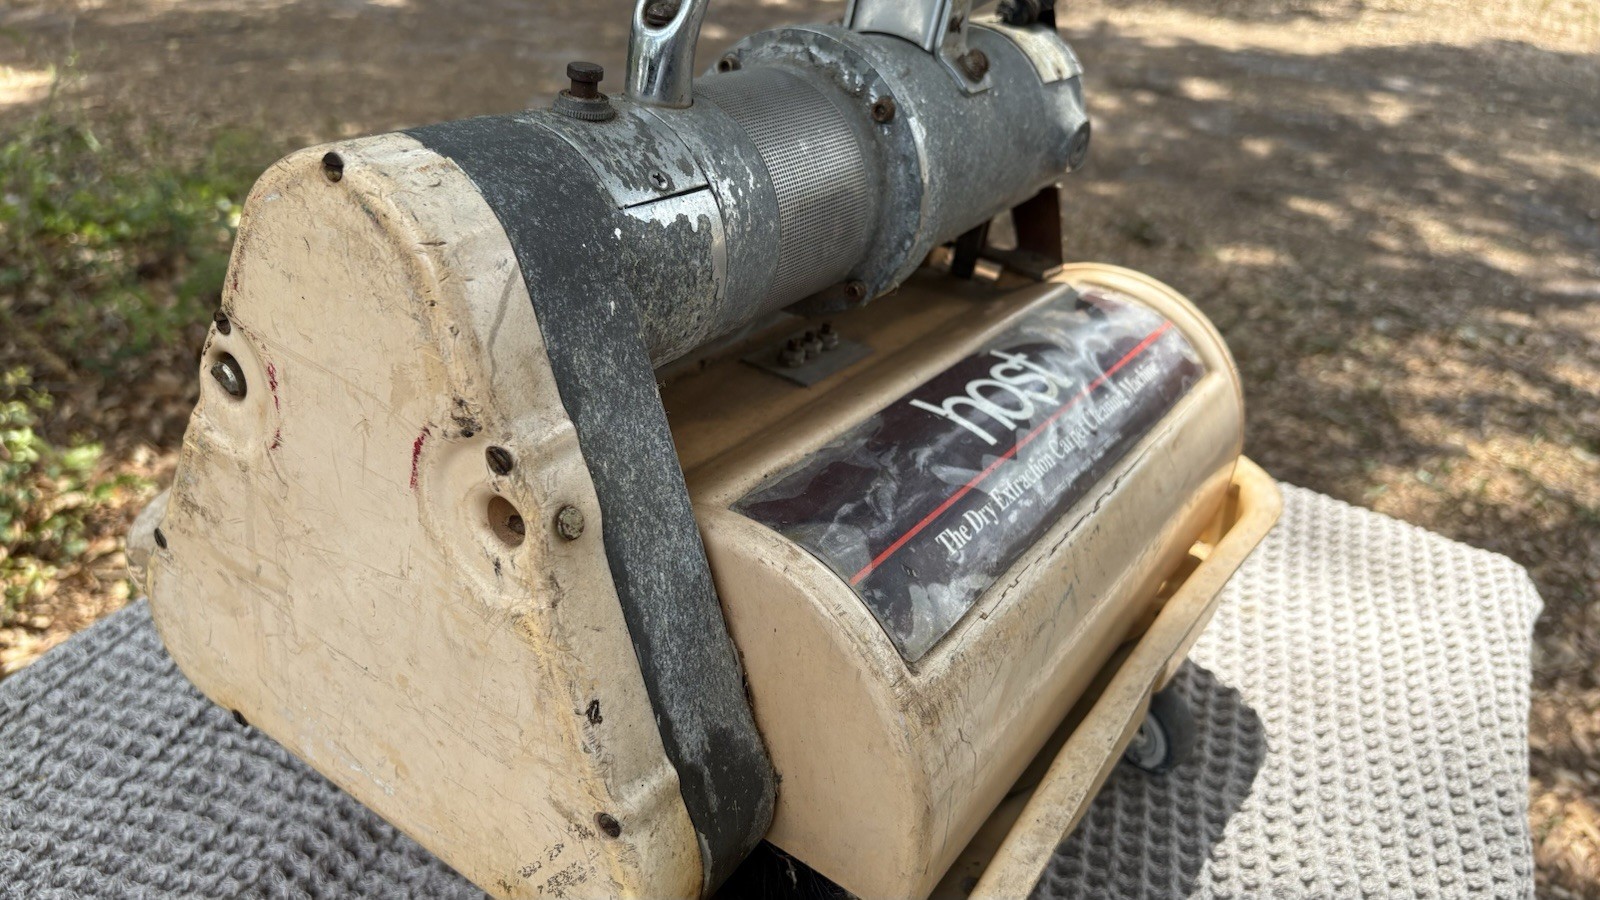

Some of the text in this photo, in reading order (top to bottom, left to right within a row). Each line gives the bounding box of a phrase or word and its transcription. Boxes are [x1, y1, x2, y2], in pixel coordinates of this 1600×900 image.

[909, 350, 1073, 446] host
[934, 527, 973, 556] The
[962, 502, 999, 526] Dry
[987, 453, 1057, 512] Extraction
[1048, 420, 1091, 459] Carpet
[1082, 392, 1131, 429] Cleaning
[1118, 362, 1160, 394] Machine
